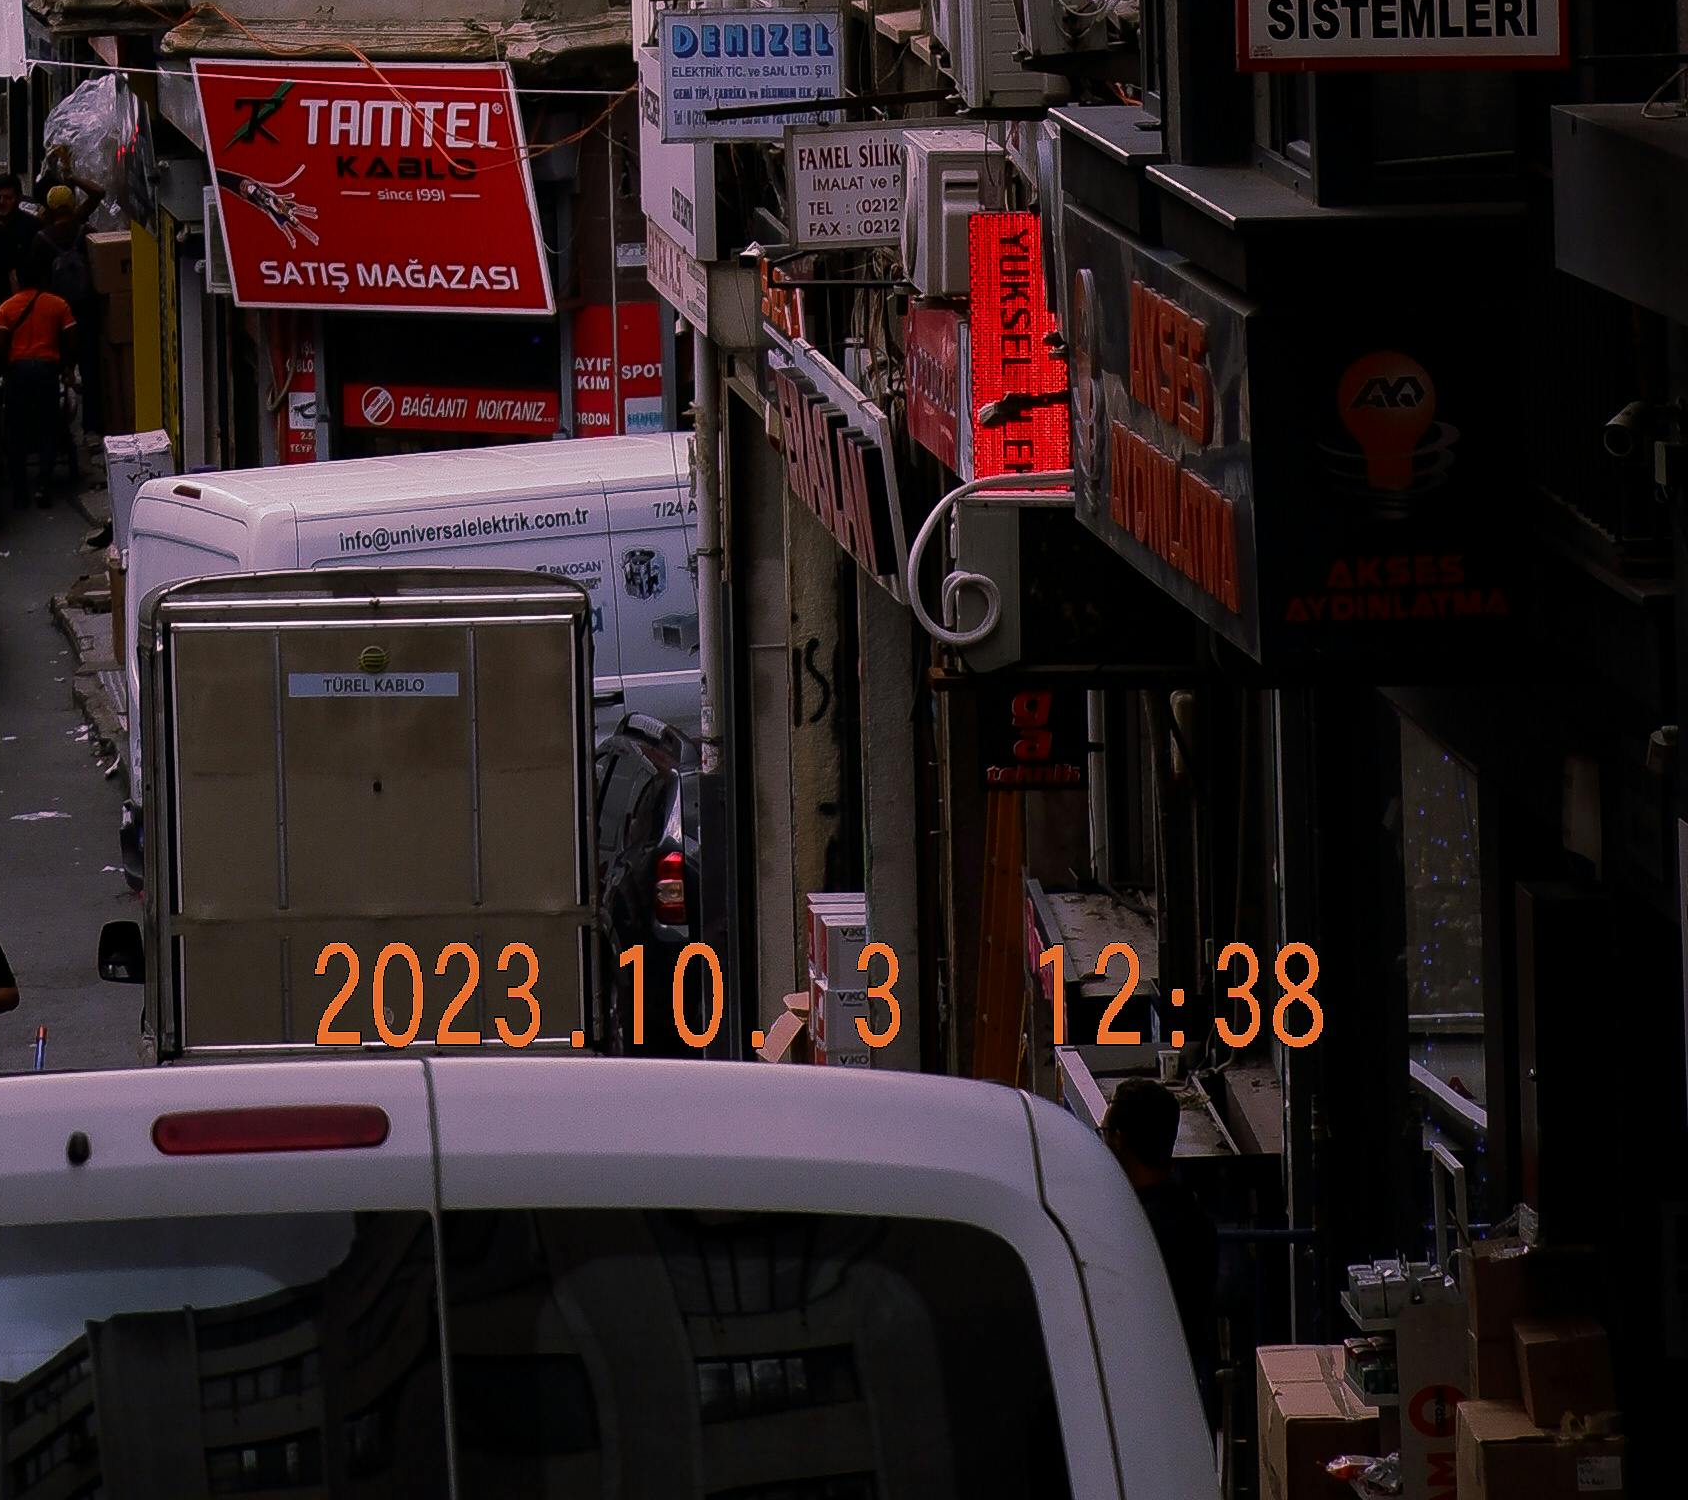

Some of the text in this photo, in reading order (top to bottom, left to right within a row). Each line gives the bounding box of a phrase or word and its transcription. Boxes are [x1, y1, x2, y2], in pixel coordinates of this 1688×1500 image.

[671, 23, 835, 59] DENIZEL
[671, 63, 725, 79] ELEKTRİK
[726, 63, 746, 78] TİC.
[747, 66, 761, 78] ve
[761, 64, 788, 78] SAN.
[789, 64, 813, 78] LTD.
[299, 97, 499, 150] TAMTEL
[335, 154, 479, 182] KABLO
[798, 146, 853, 173] FAMEL
[812, 174, 864, 193] İMALAT
[869, 176, 888, 190] ve
[376, 188, 446, 202] since 1991
[808, 198, 898, 216] TEL (0212
[808, 221, 841, 238] FAX
[259, 258, 520, 294] SATIŞ MAĞAZASI
[400, 393, 468, 419] BAĞLANTI
[652, 501, 683, 519] 7/24
[339, 506, 590, 554] info@universalelektrik.com.tr
[322, 676, 425, 693] TÜREL KABLO
